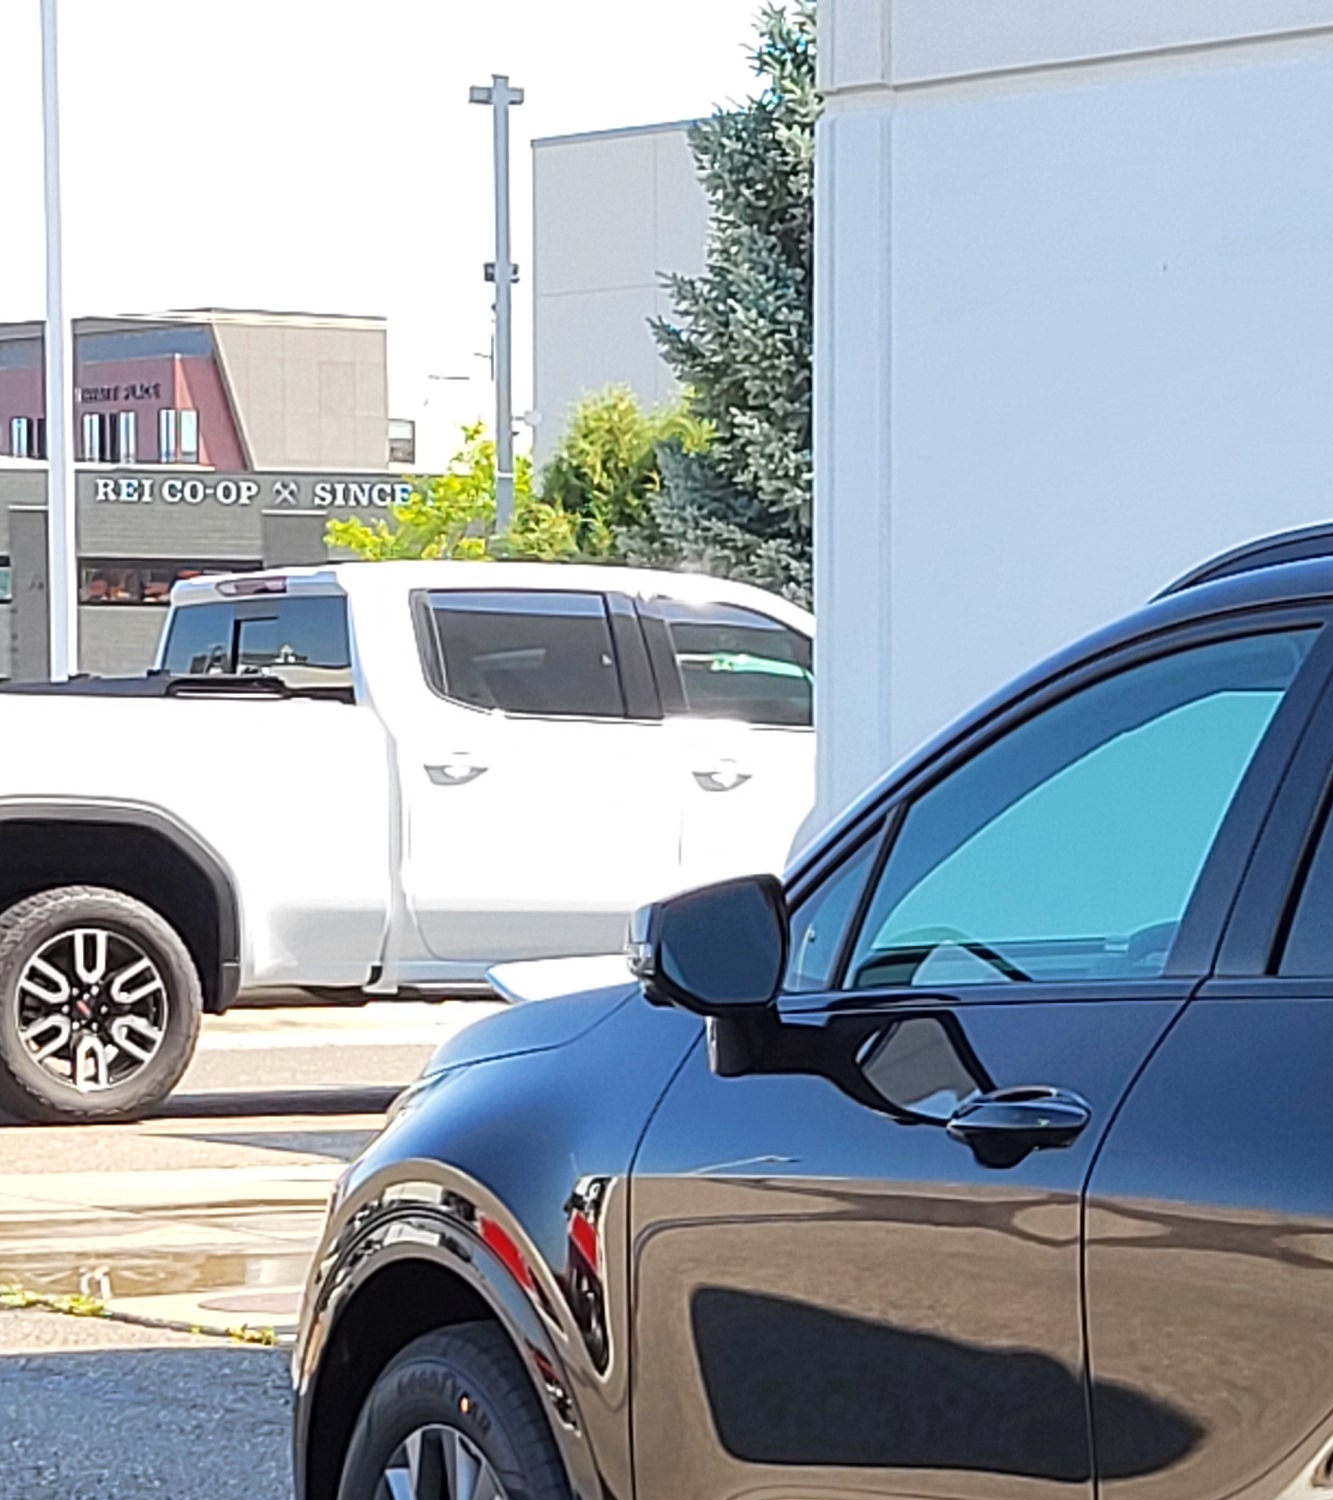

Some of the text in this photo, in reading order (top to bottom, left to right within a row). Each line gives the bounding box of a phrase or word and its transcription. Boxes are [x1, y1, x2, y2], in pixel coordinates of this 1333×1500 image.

[96, 479, 153, 502] REI
[162, 479, 258, 505] CO-OP
[313, 482, 414, 506] SINCE
